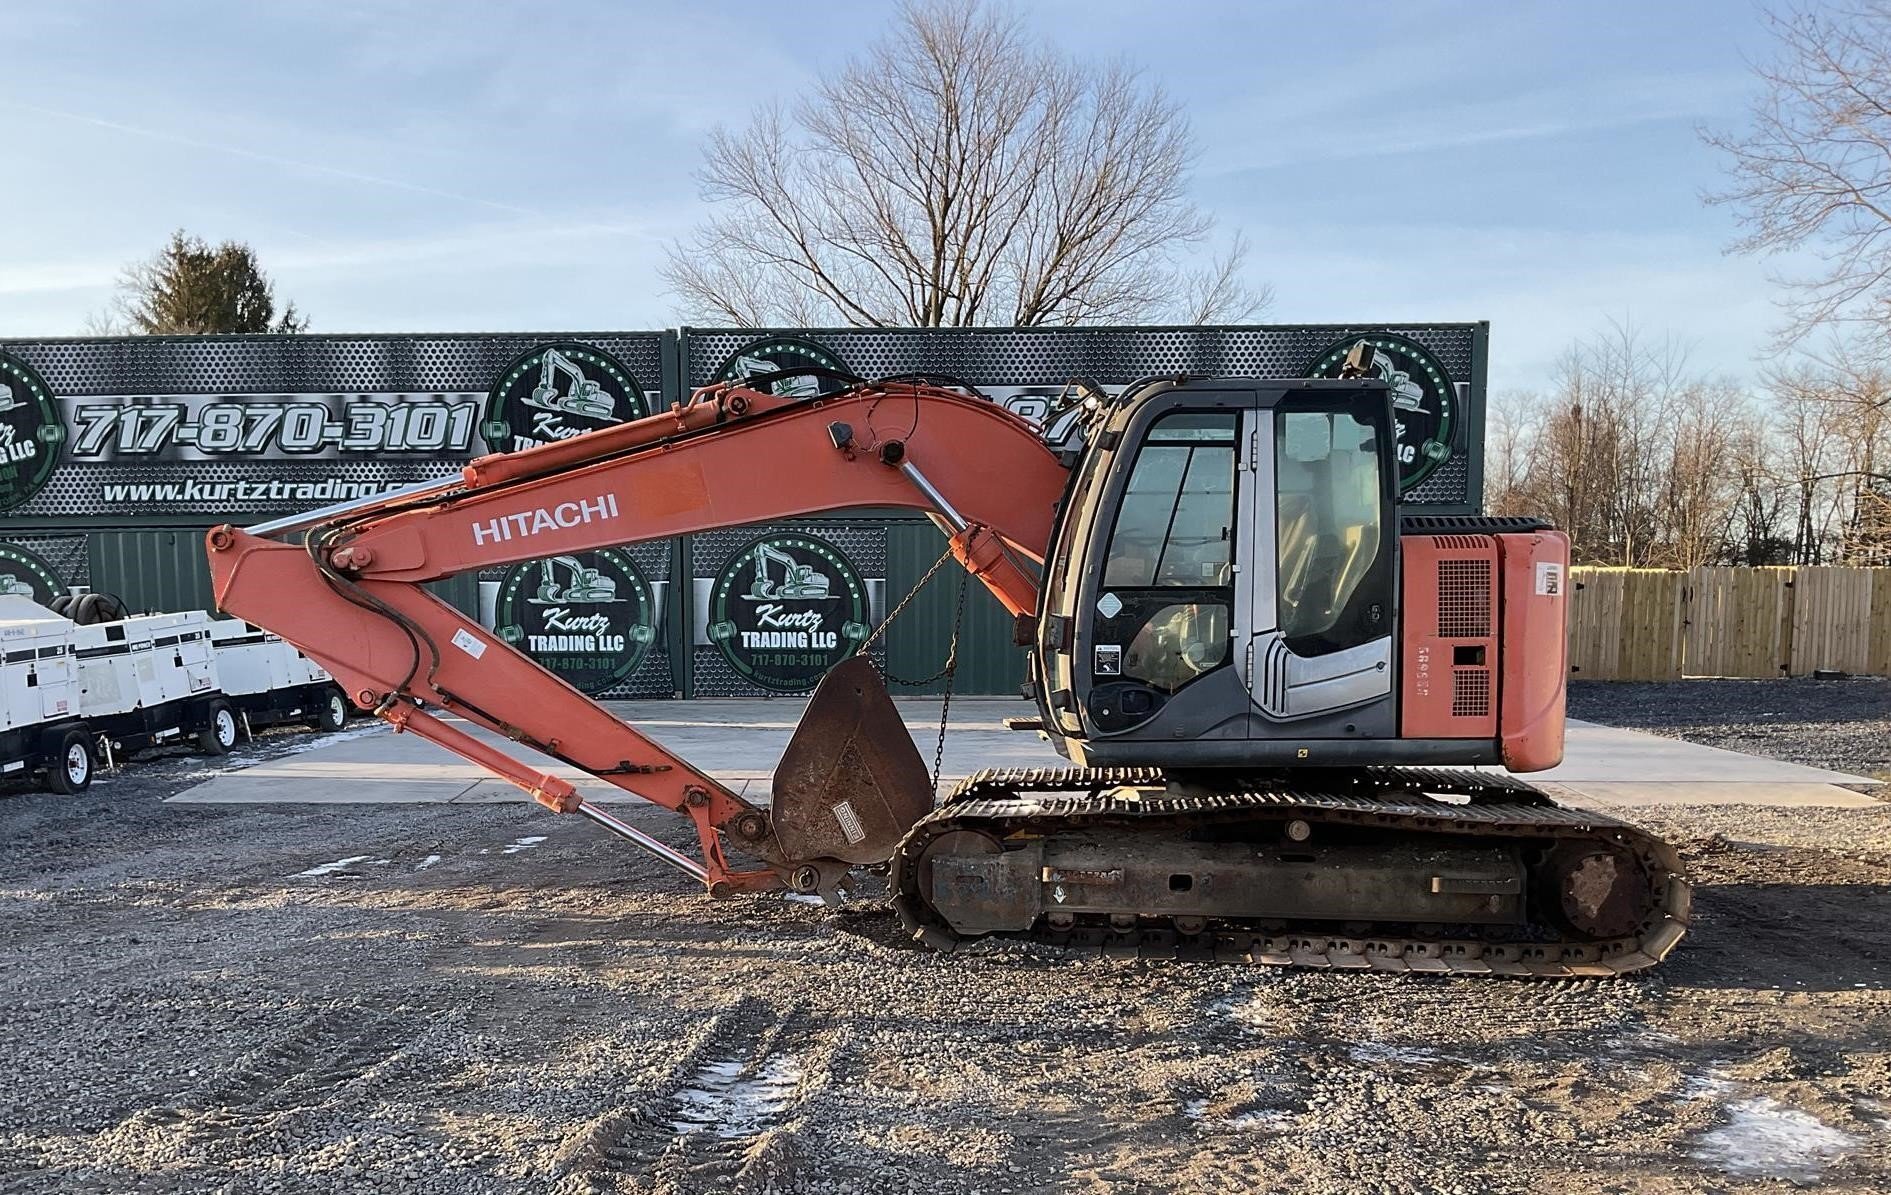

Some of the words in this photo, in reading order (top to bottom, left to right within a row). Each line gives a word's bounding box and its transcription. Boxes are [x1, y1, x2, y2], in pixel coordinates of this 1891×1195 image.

[73, 403, 474, 453] 717-870-3101
[532, 412, 592, 440] Kur
[472, 493, 619, 546] HITACHI
[542, 607, 610, 637] Kurtz
[755, 603, 824, 633] Kurtz
[528, 635, 596, 652] TRADING
[599, 635, 625, 651] LLC
[741, 631, 808, 649] TRADING
[811, 631, 837, 649] LLC
